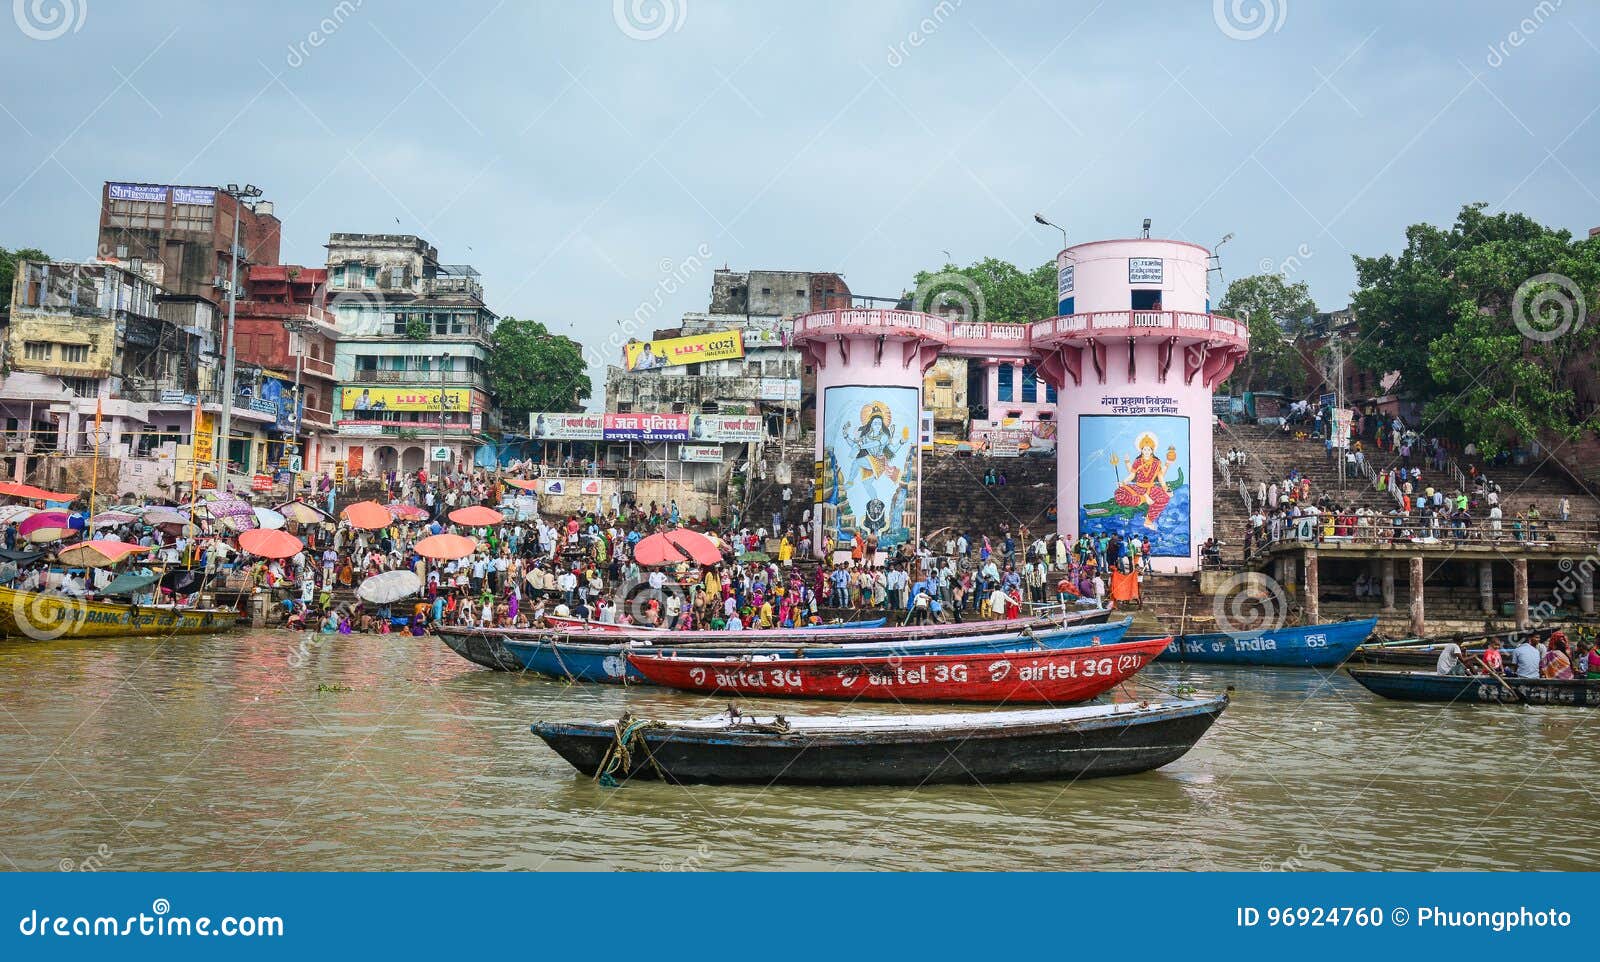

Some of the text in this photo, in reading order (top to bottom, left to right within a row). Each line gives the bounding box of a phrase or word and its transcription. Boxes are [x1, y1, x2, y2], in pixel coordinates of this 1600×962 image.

[111, 185, 131, 199] Shri
[175, 189, 192, 203] Shri
[675, 336, 735, 356] LUX cozi
[396, 395, 428, 404] LUX
[1101, 395, 1118, 406] गंगा
[615, 415, 678, 434] जल पुलिस
[86, 609, 121, 625] BANK
[1234, 637, 1278, 651] India
[1306, 636, 1327, 648] 65
[934, 663, 968, 683] 3G
[1019, 654, 1141, 681] airtel 3G (21)
[714, 668, 803, 688] airtel 3G
